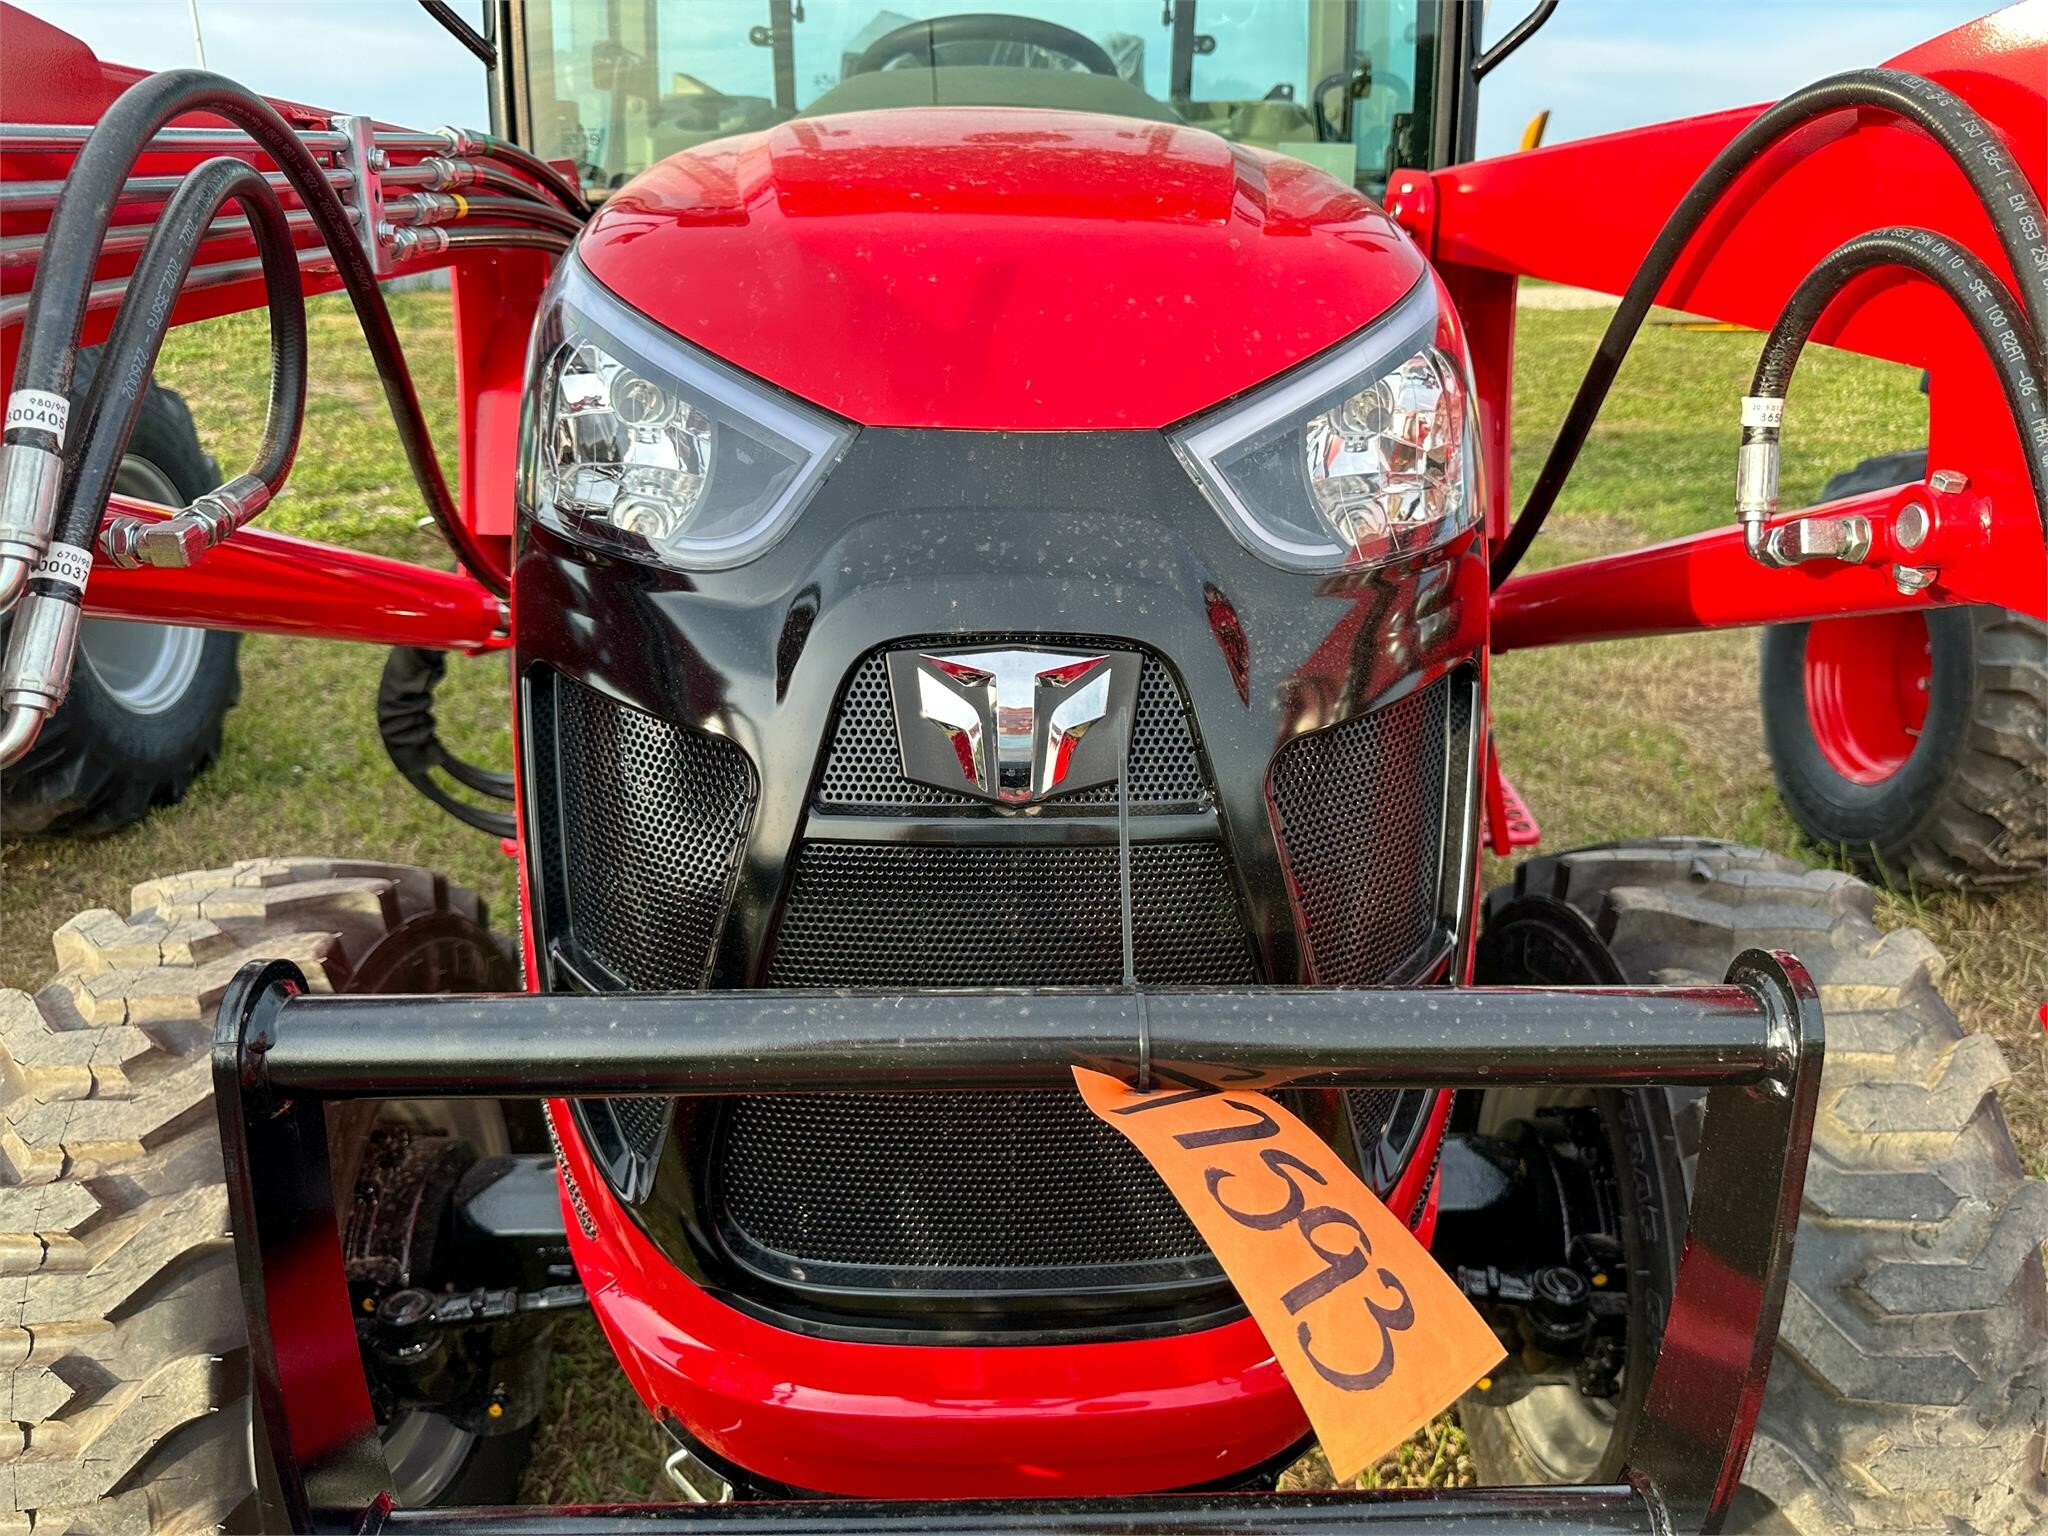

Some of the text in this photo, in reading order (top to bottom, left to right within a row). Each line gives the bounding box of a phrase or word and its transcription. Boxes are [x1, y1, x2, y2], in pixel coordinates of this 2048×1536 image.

[301, 168, 319, 192] 2022
[1960, 119, 1984, 138] ISO
[1976, 140, 2011, 177] 1436-1
[2007, 193, 2029, 212] EN
[2018, 215, 2041, 241] 853
[2030, 245, 2048, 273] 2SN
[180, 218, 198, 247] 2022
[1911, 232, 1936, 248] 2SN
[1931, 242, 1952, 257] DN
[1947, 254, 1965, 269] 10
[1968, 278, 1993, 303] SAE
[1985, 303, 2008, 328] 100
[1998, 329, 2026, 363] R2AT
[2018, 370, 2038, 397] -06
[2031, 417, 2048, 448] MAX
[122, 346, 149, 400] 226002
[29, 397, 66, 415] 980/90
[31, 560, 88, 583] 00037
[57, 550, 90, 569] 670/90
[1110, 1087, 1415, 1392] 17593
